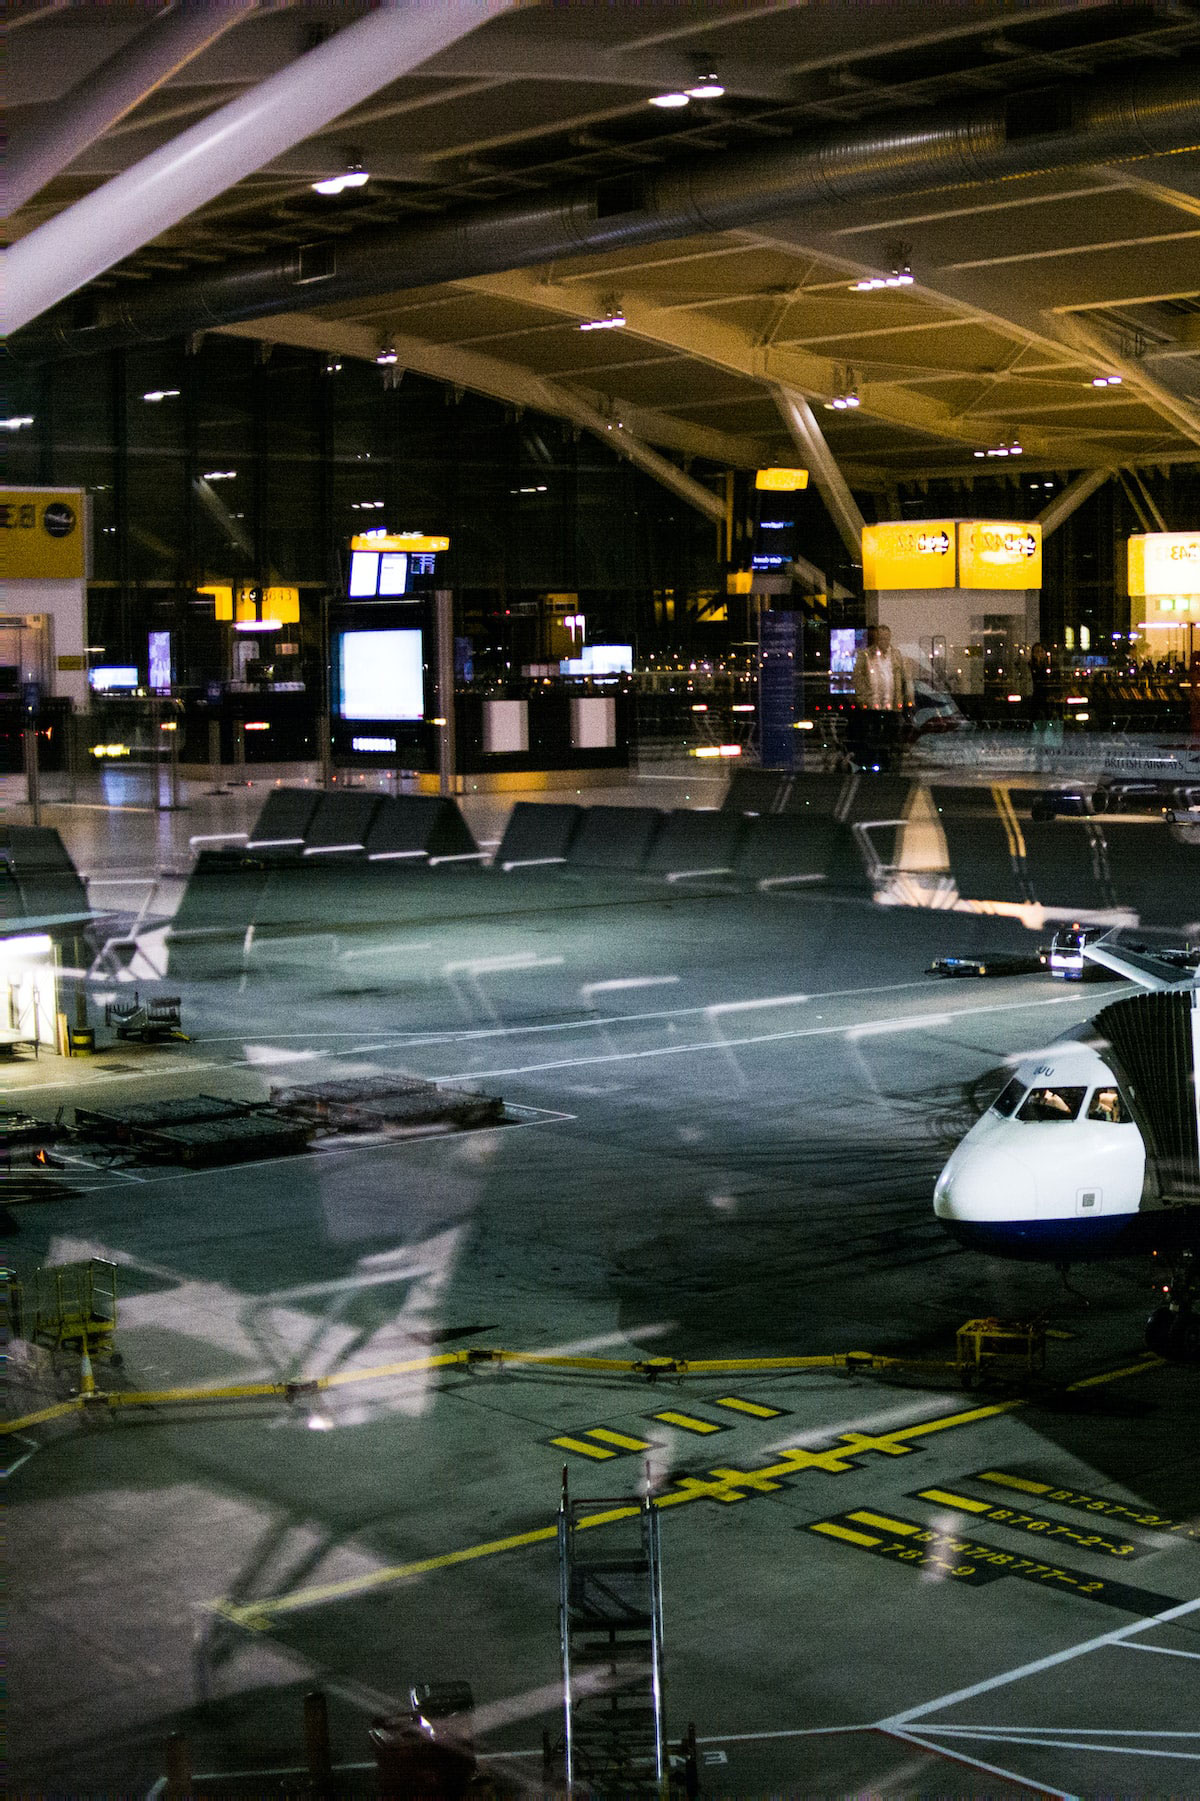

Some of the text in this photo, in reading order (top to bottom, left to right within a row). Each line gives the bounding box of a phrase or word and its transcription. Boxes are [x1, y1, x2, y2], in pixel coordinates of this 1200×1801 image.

[1104, 759, 1184, 770] BRITISH AIRWAYS
[987, 1509, 1135, 1556] B767-2-3
